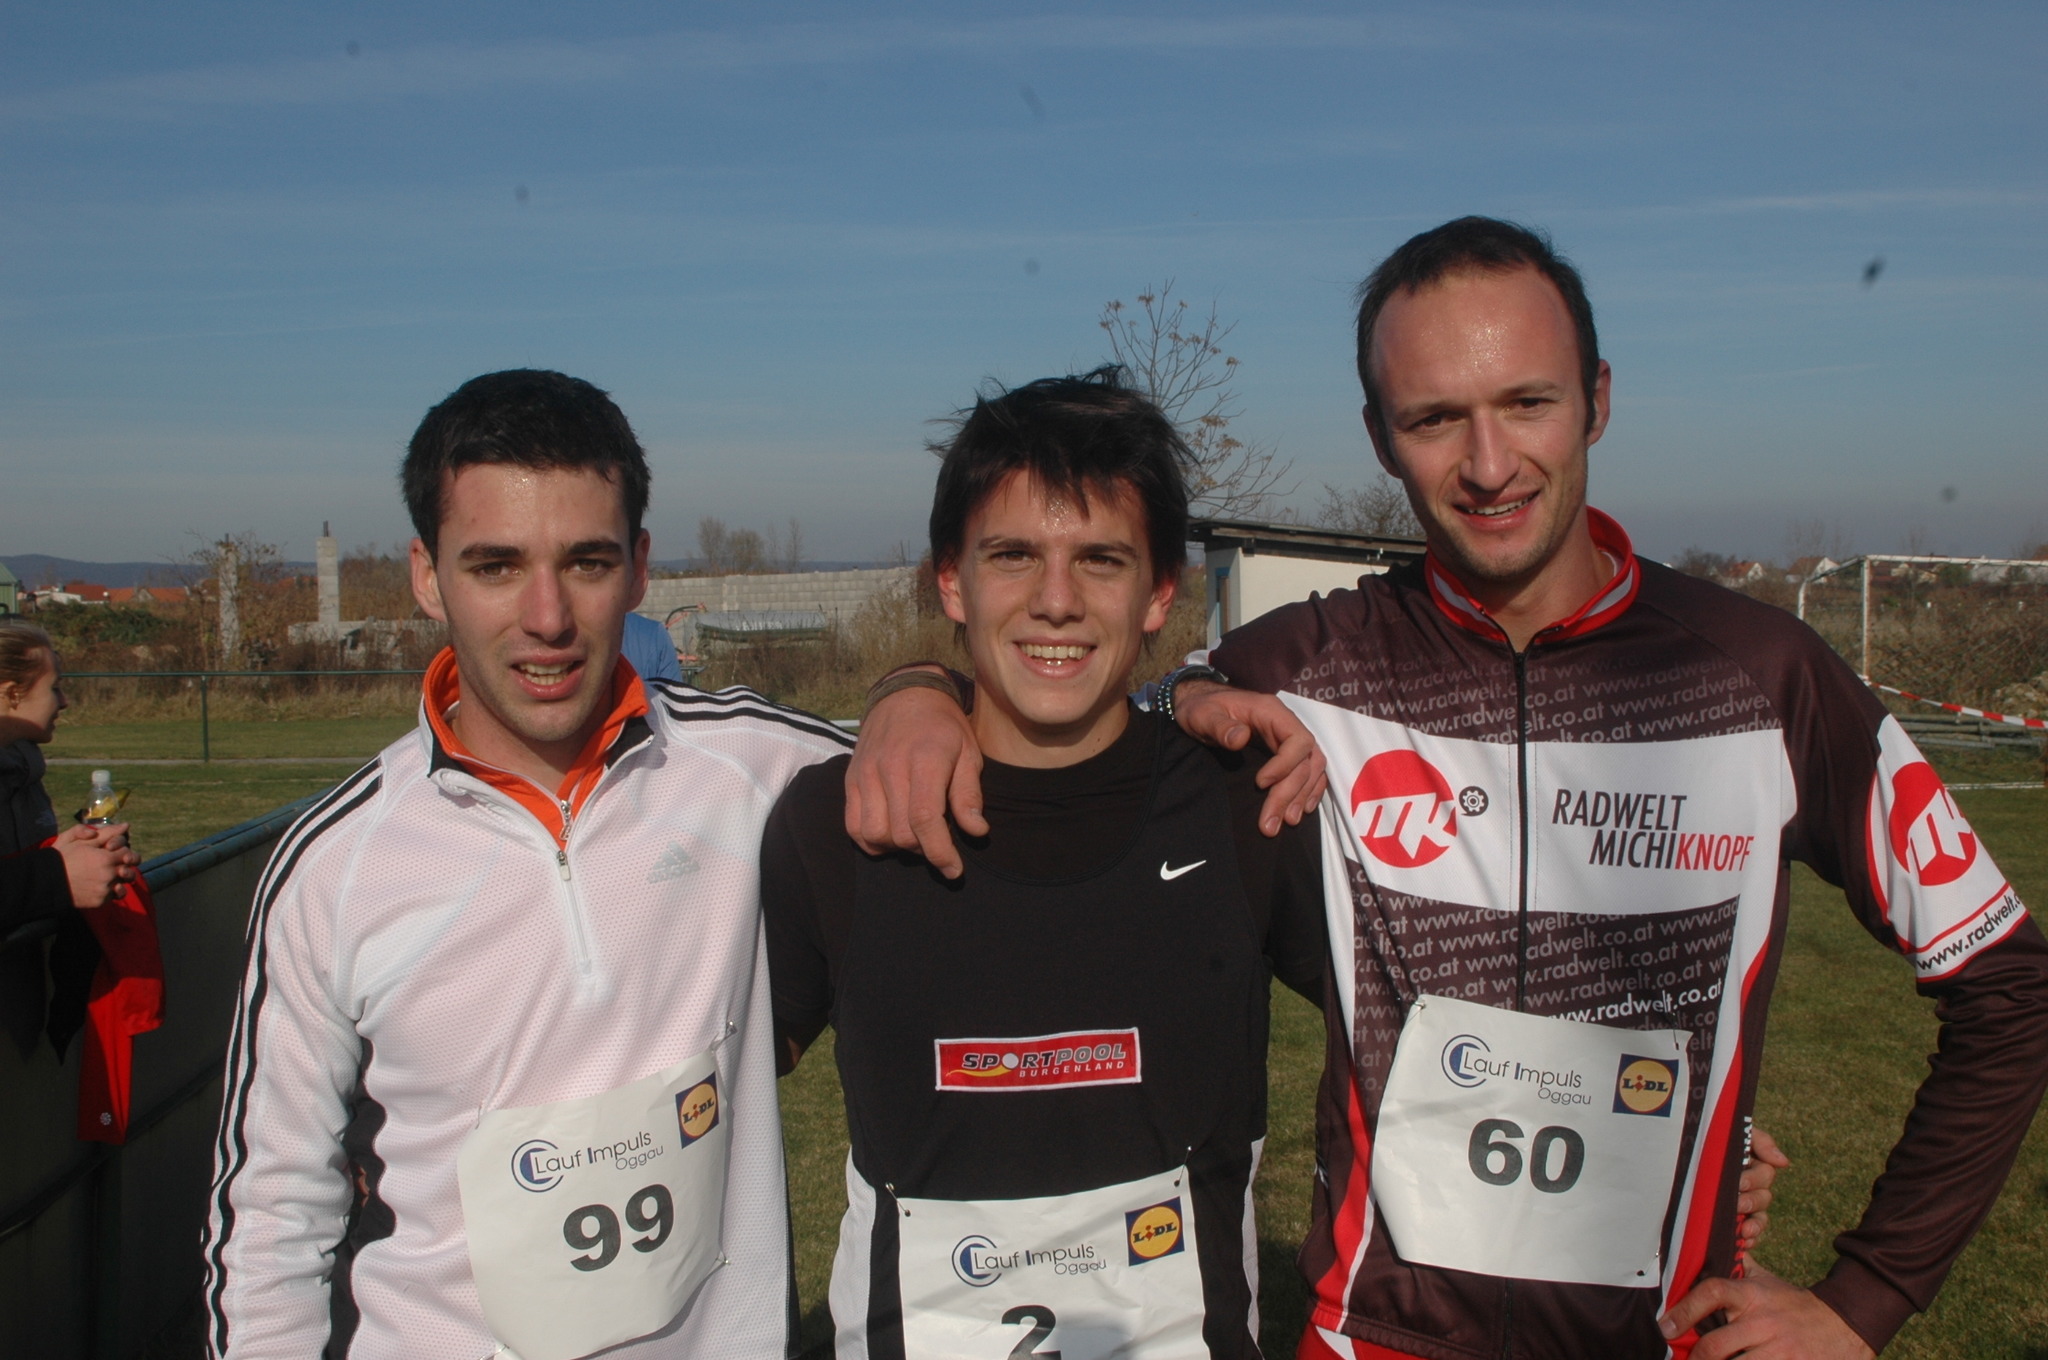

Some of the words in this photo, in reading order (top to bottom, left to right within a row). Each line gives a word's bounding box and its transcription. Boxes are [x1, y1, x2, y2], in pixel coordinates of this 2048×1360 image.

[1552, 788, 1688, 831] RADWELT
[1019, 1061, 1125, 1079] BURGENLAND
[1463, 1051, 1510, 1076] Lauf
[1514, 1063, 1582, 1088] Impuls
[1538, 1087, 1592, 1106] Oggau
[535, 1150, 582, 1175] Lauf
[588, 1131, 652, 1164] Impuls
[615, 1146, 664, 1171] Oggau
[1468, 1118, 1586, 1194] 60
[563, 1184, 674, 1272] 99
[974, 1250, 1020, 1271] Lauf
[1025, 1243, 1096, 1268] Impuls
[1054, 1259, 1107, 1276] Oggau
[1001, 1305, 1062, 1360] 2
